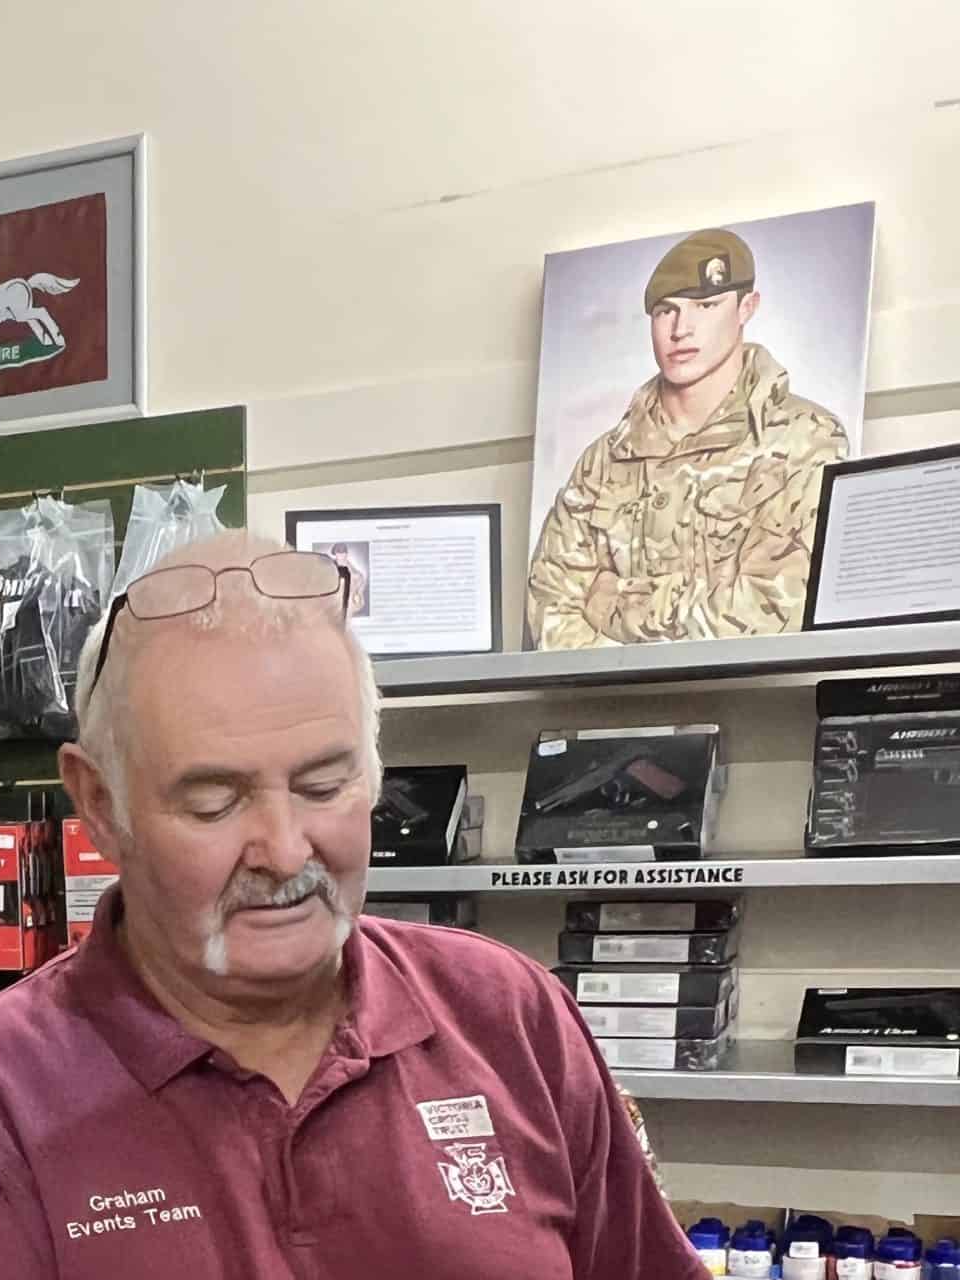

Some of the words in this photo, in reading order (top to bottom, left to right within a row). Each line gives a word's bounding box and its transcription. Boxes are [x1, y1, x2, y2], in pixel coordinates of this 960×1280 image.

[491, 871, 552, 886] PLEASE
[557, 870, 589, 885] ASK
[593, 870, 628, 885] FOR
[634, 867, 744, 884] ASSISTANCE
[90, 1188, 166, 1212] Graham
[66, 1214, 136, 1239] Events
[143, 1205, 202, 1225] Team
